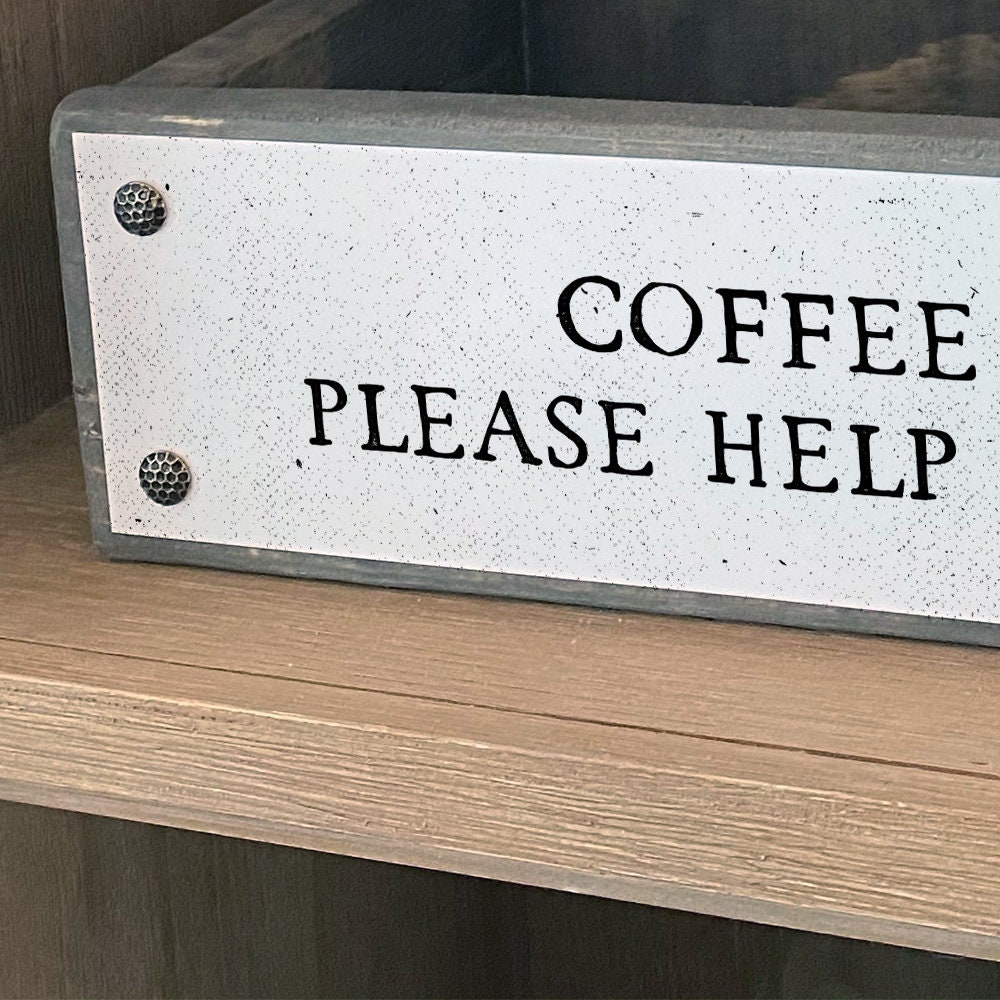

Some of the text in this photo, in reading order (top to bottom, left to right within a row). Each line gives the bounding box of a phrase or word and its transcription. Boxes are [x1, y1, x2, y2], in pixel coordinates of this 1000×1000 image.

[556, 276, 976, 380] COFFEE
[304, 379, 653, 476] PLEASE
[706, 411, 956, 500] HELP
